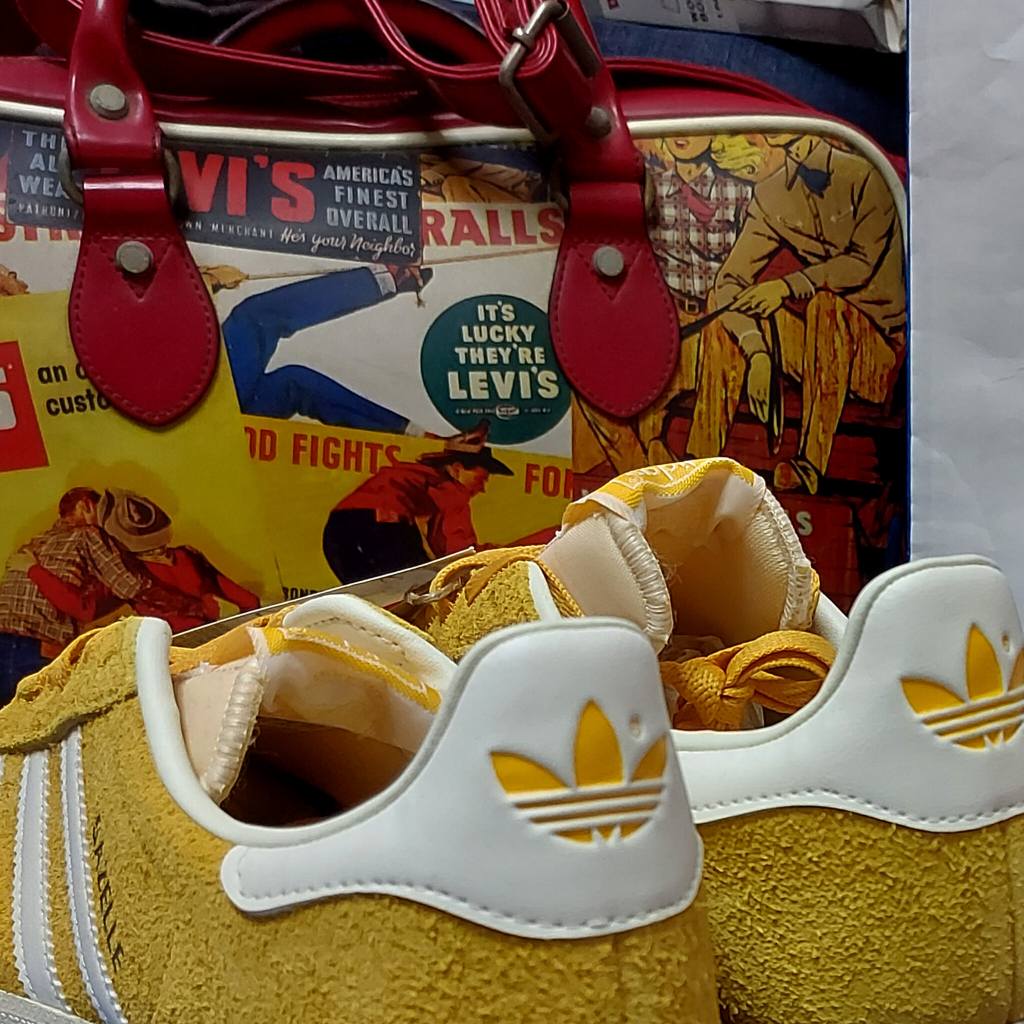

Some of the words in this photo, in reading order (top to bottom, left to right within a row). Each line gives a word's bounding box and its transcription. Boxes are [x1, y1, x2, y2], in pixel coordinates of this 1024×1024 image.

[323, 165, 414, 187] AMERICA'S
[334, 185, 409, 210] FINEST
[326, 207, 413, 235] OVERALL
[279, 226, 306, 244] He's
[312, 234, 347, 254] your
[350, 233, 417, 260] Neighbor
[478, 300, 516, 322] IT'S
[461, 325, 536, 343] LUCKY
[454, 343, 546, 365] THEY'RE
[37, 364, 68, 384] an
[447, 366, 560, 400] LEVI'S
[292, 432, 402, 475] FIGHTS
